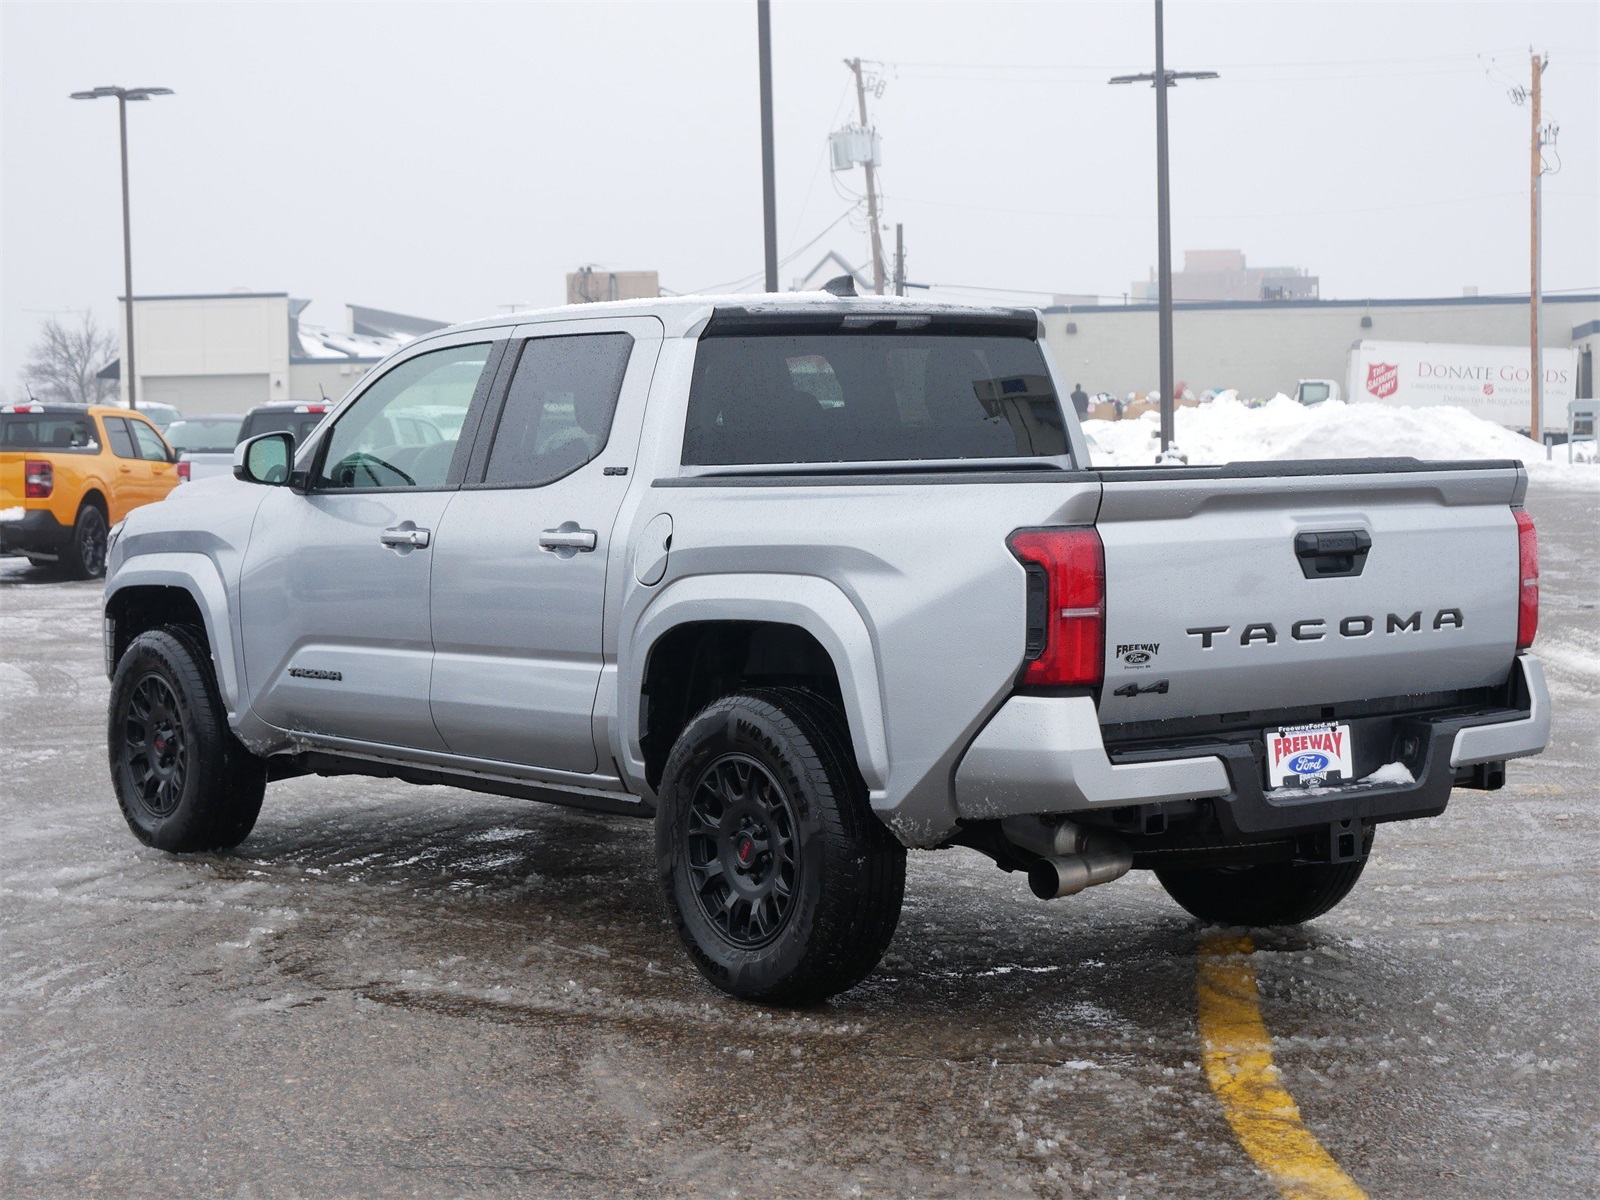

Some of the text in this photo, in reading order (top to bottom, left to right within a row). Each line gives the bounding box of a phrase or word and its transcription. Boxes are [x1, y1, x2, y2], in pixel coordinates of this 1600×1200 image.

[1367, 367, 1397, 390] SALVATION
[1372, 364, 1386, 377] THE
[1418, 361, 1568, 384] DONATE GODS
[1376, 377, 1396, 395] ARMY
[1185, 607, 1464, 650] TACOMA
[1116, 642, 1160, 659] FREEWAY
[288, 667, 343, 681] TACOMA
[1278, 721, 1339, 732] FreewayFord.net
[1274, 732, 1342, 768] FREEWAY
[1295, 755, 1322, 771] Ford
